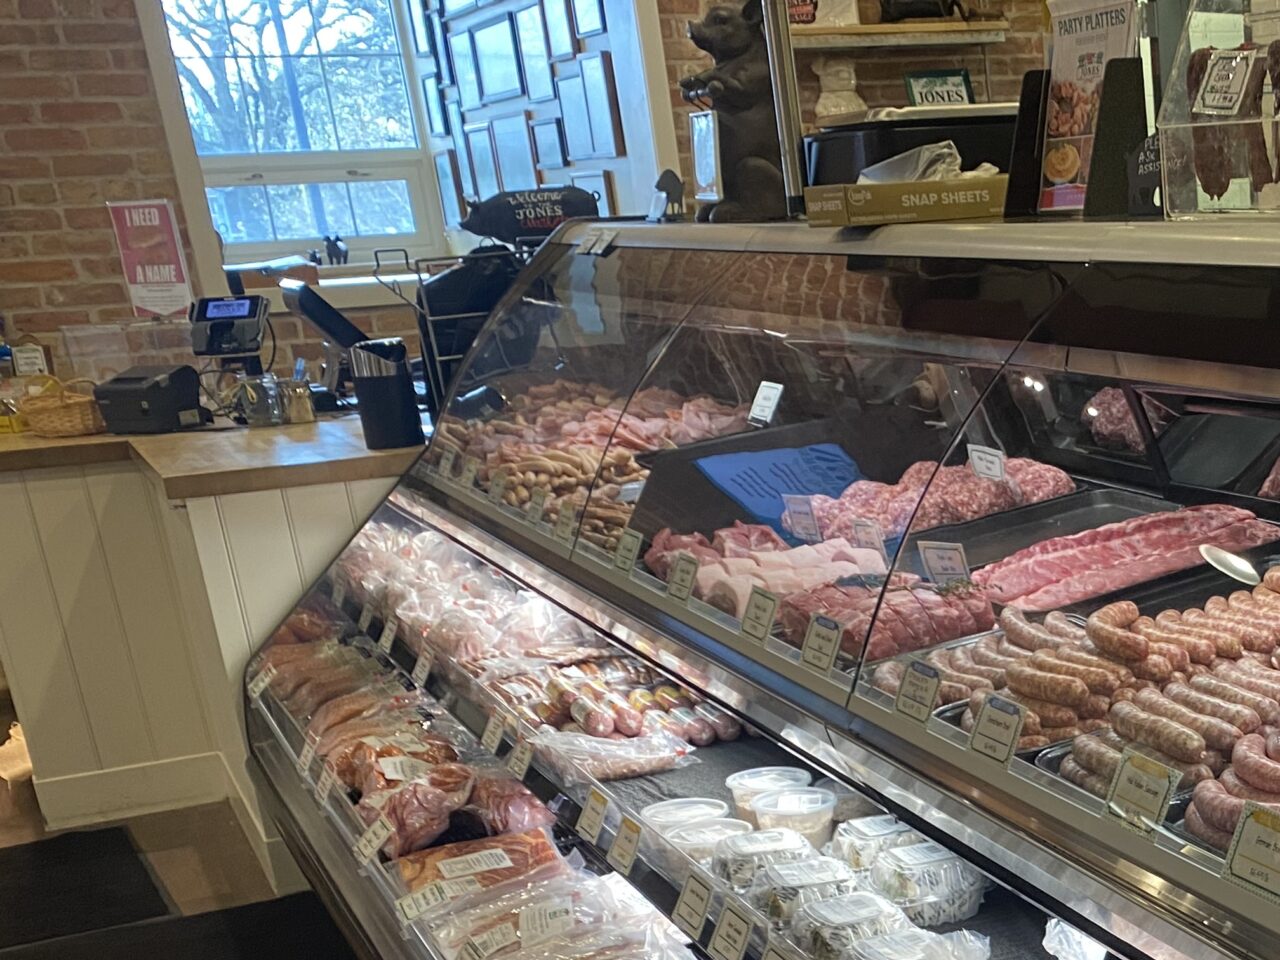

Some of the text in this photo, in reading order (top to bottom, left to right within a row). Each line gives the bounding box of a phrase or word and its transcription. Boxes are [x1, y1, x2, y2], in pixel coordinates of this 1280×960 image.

[1058, 8, 1126, 36] PARTY PLATTERS
[917, 89, 964, 105] JONES
[901, 190, 990, 207] SNAP SHEETS
[124, 207, 160, 227] I NEED
[515, 204, 563, 220] JONES
[136, 264, 177, 284] A NAME
